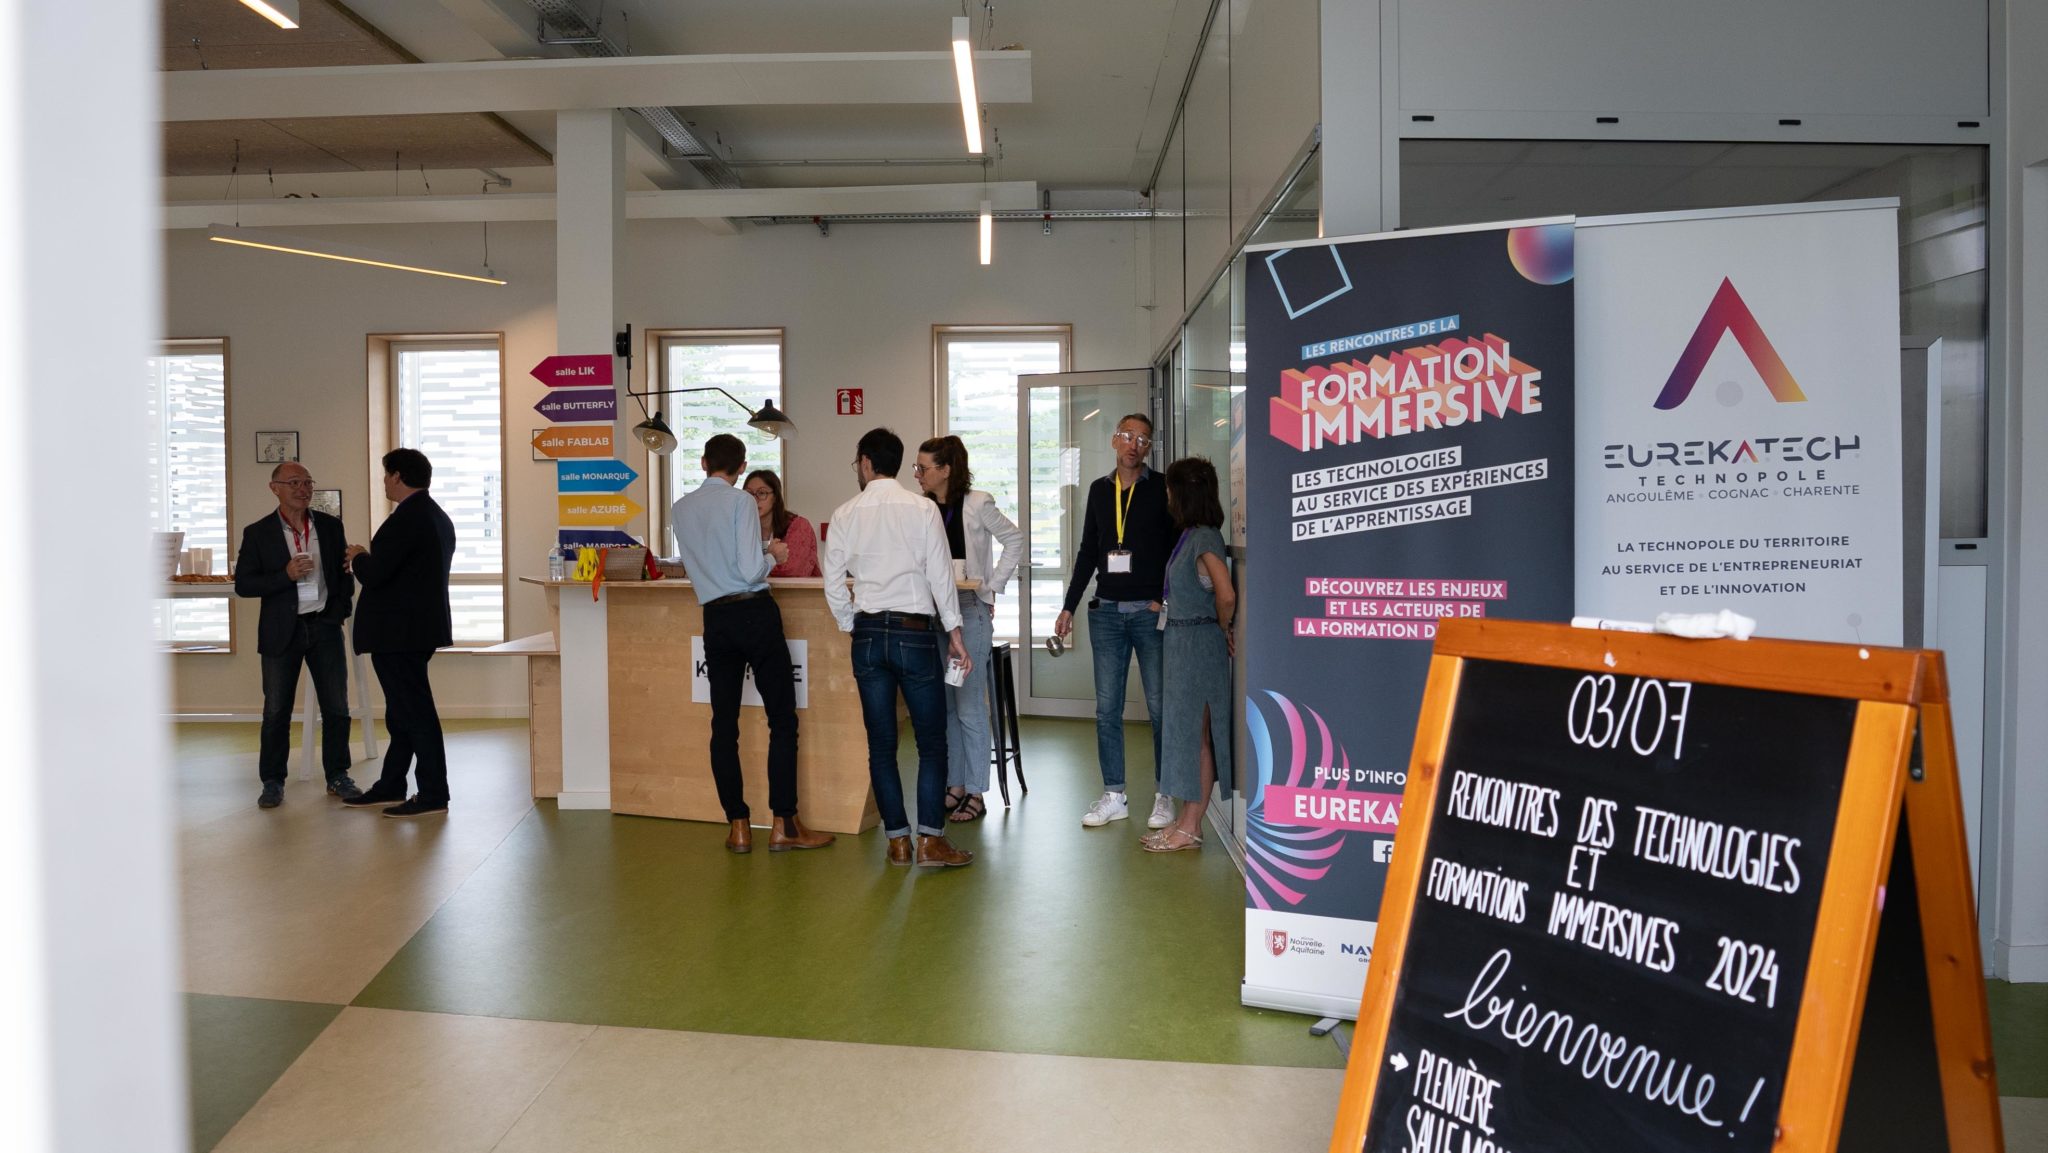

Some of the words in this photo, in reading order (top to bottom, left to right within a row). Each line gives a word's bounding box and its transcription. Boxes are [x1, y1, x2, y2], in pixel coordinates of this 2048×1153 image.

[1306, 345, 1325, 358] LES
[1330, 326, 1414, 352] RENCONTRES
[1419, 321, 1436, 335] DE
[1440, 319, 1456, 331] LA
[555, 368, 576, 376] salle
[578, 366, 595, 375] LIK
[1302, 342, 1510, 411] FORMATION
[541, 402, 561, 411] salle
[563, 401, 614, 410] BUTTERFLY
[1302, 371, 1543, 452] IMMERSIVE
[541, 438, 564, 447] salle
[567, 437, 609, 446] FABLAB
[1604, 434, 1860, 469] EUREKATECH
[561, 473, 580, 481] salle
[582, 472, 630, 480] MONARQUE
[1296, 472, 1321, 489] LES
[1326, 451, 1456, 484] TECHNOLOGIES
[1638, 469, 1826, 487] TECHNOPOLE
[1296, 499, 1318, 513] AU
[1324, 486, 1388, 509] SERVICE
[1394, 481, 1425, 498] DES
[1431, 462, 1544, 493] EXPÉRIENCES
[1606, 489, 1694, 504] ANGOULÊME
[1708, 488, 1769, 500] COGNAC
[1783, 485, 1860, 497] CHARENTE
[567, 506, 587, 514] salle
[590, 503, 626, 514] AZURÉ
[1296, 521, 1316, 537] DE
[1322, 499, 1467, 534] L'APPRENTISSAGE
[1617, 543, 1634, 553] LA
[1639, 539, 1735, 552] TECHNOPOLE
[1739, 538, 1759, 549] DU
[1764, 536, 1850, 548] TERRITOIRE
[1602, 565, 1620, 575] AU
[1625, 563, 1684, 574] SERVICE
[1689, 562, 1707, 573] DE
[1712, 558, 1863, 572] L'ENTREPRENEURIAT
[1309, 578, 1404, 596] DÉCOUVREZ
[1409, 582, 1436, 596] LES
[1441, 583, 1504, 598] ENJEUX
[1660, 585, 1676, 596] ET
[1681, 584, 1699, 595] DE
[1704, 582, 1806, 594] L'INNOVATION
[1329, 601, 1347, 615] ET
[1352, 602, 1378, 616] LES
[1383, 603, 1454, 618] ACTEURS
[1460, 604, 1481, 618] DE
[1297, 620, 1316, 635] LA
[1321, 621, 1418, 638] FORMATION
[1567, 674, 1692, 760] 03/07
[1314, 766, 1350, 781] PLUS
[1295, 794, 1402, 826] EUREKA
[1447, 770, 1560, 838] RENCONTRES
[1577, 796, 1618, 849] DES
[1633, 805, 1801, 894] TECHNOLOGIES
[1566, 845, 1607, 891] ET
[1548, 891, 1680, 973] IMMERSIVES
[1705, 936, 1780, 1009] 2024
[1443, 948, 1724, 1127] bienvenue
[1413, 1049, 1502, 1136] PLENIÈRE
